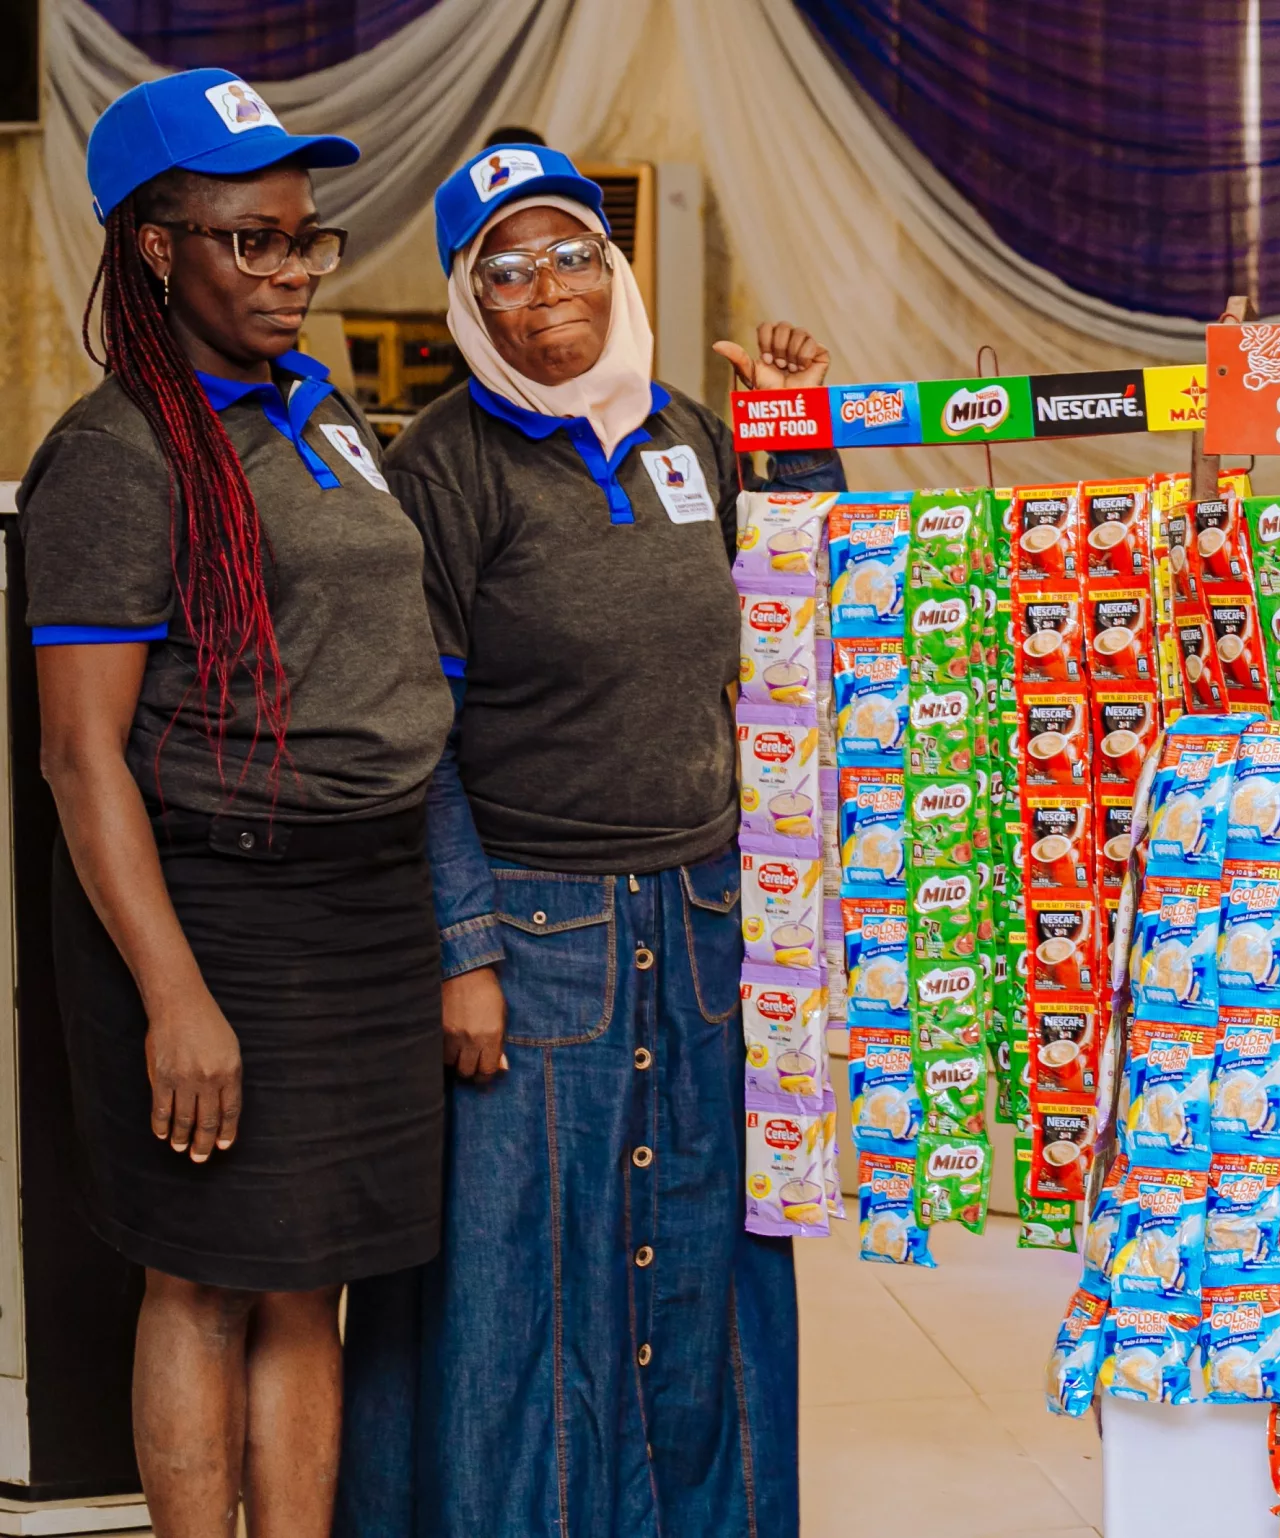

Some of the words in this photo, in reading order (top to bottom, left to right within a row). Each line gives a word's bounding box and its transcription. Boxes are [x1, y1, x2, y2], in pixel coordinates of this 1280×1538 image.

[748, 394, 805, 419] NESTLÉ
[841, 391, 903, 423] GOLDEN
[1038, 384, 1139, 421] NESCAFÉ
[952, 397, 1002, 424] MILO
[1170, 407, 1207, 421] MAG
[865, 411, 902, 427] MORN
[740, 421, 776, 438] BABY
[779, 419, 817, 436] FOOD
[879, 510, 907, 519] FREE
[920, 515, 964, 532] MILO
[851, 525, 895, 544] GOLDEN
[750, 610, 788, 622] Cerelac
[918, 610, 960, 626] MILO
[855, 660, 899, 678] GOLDEN
[918, 702, 962, 719] MILO
[754, 740, 792, 753] Cerelac
[859, 791, 903, 807] GOLDEN
[921, 795, 966, 811] MILO
[759, 872, 795, 886] Cerelac
[923, 886, 966, 903] MILO
[1185, 884, 1211, 896] FREE
[1231, 887, 1280, 903] GOLDEN
[1161, 903, 1198, 920] GOLDEN
[1248, 899, 1277, 909] MORN
[1170, 914, 1195, 926] MORN
[863, 922, 907, 939] GOLDEN
[757, 1000, 794, 1014] Cerelac
[1178, 1030, 1204, 1043] FREE
[1225, 1033, 1273, 1050] GOLDEN
[1148, 1050, 1189, 1064] GOLDEN
[1240, 1046, 1269, 1056] MORN
[1162, 1060, 1187, 1071] MORN
[933, 1155, 978, 1170] MILO
[1248, 1162, 1279, 1175] FREE
[872, 1178, 911, 1194] GOLDEN
[1219, 1180, 1263, 1198] GOLDEN
[1140, 1193, 1182, 1208] GOLDEN
[1152, 1203, 1179, 1214] MORN
[1238, 1289, 1269, 1302] FREE
[1117, 1313, 1167, 1327] GOLDEN
[1212, 1308, 1261, 1327] GOLDEN
[1136, 1322, 1166, 1333] MORN
[1230, 1319, 1260, 1332] MORN
